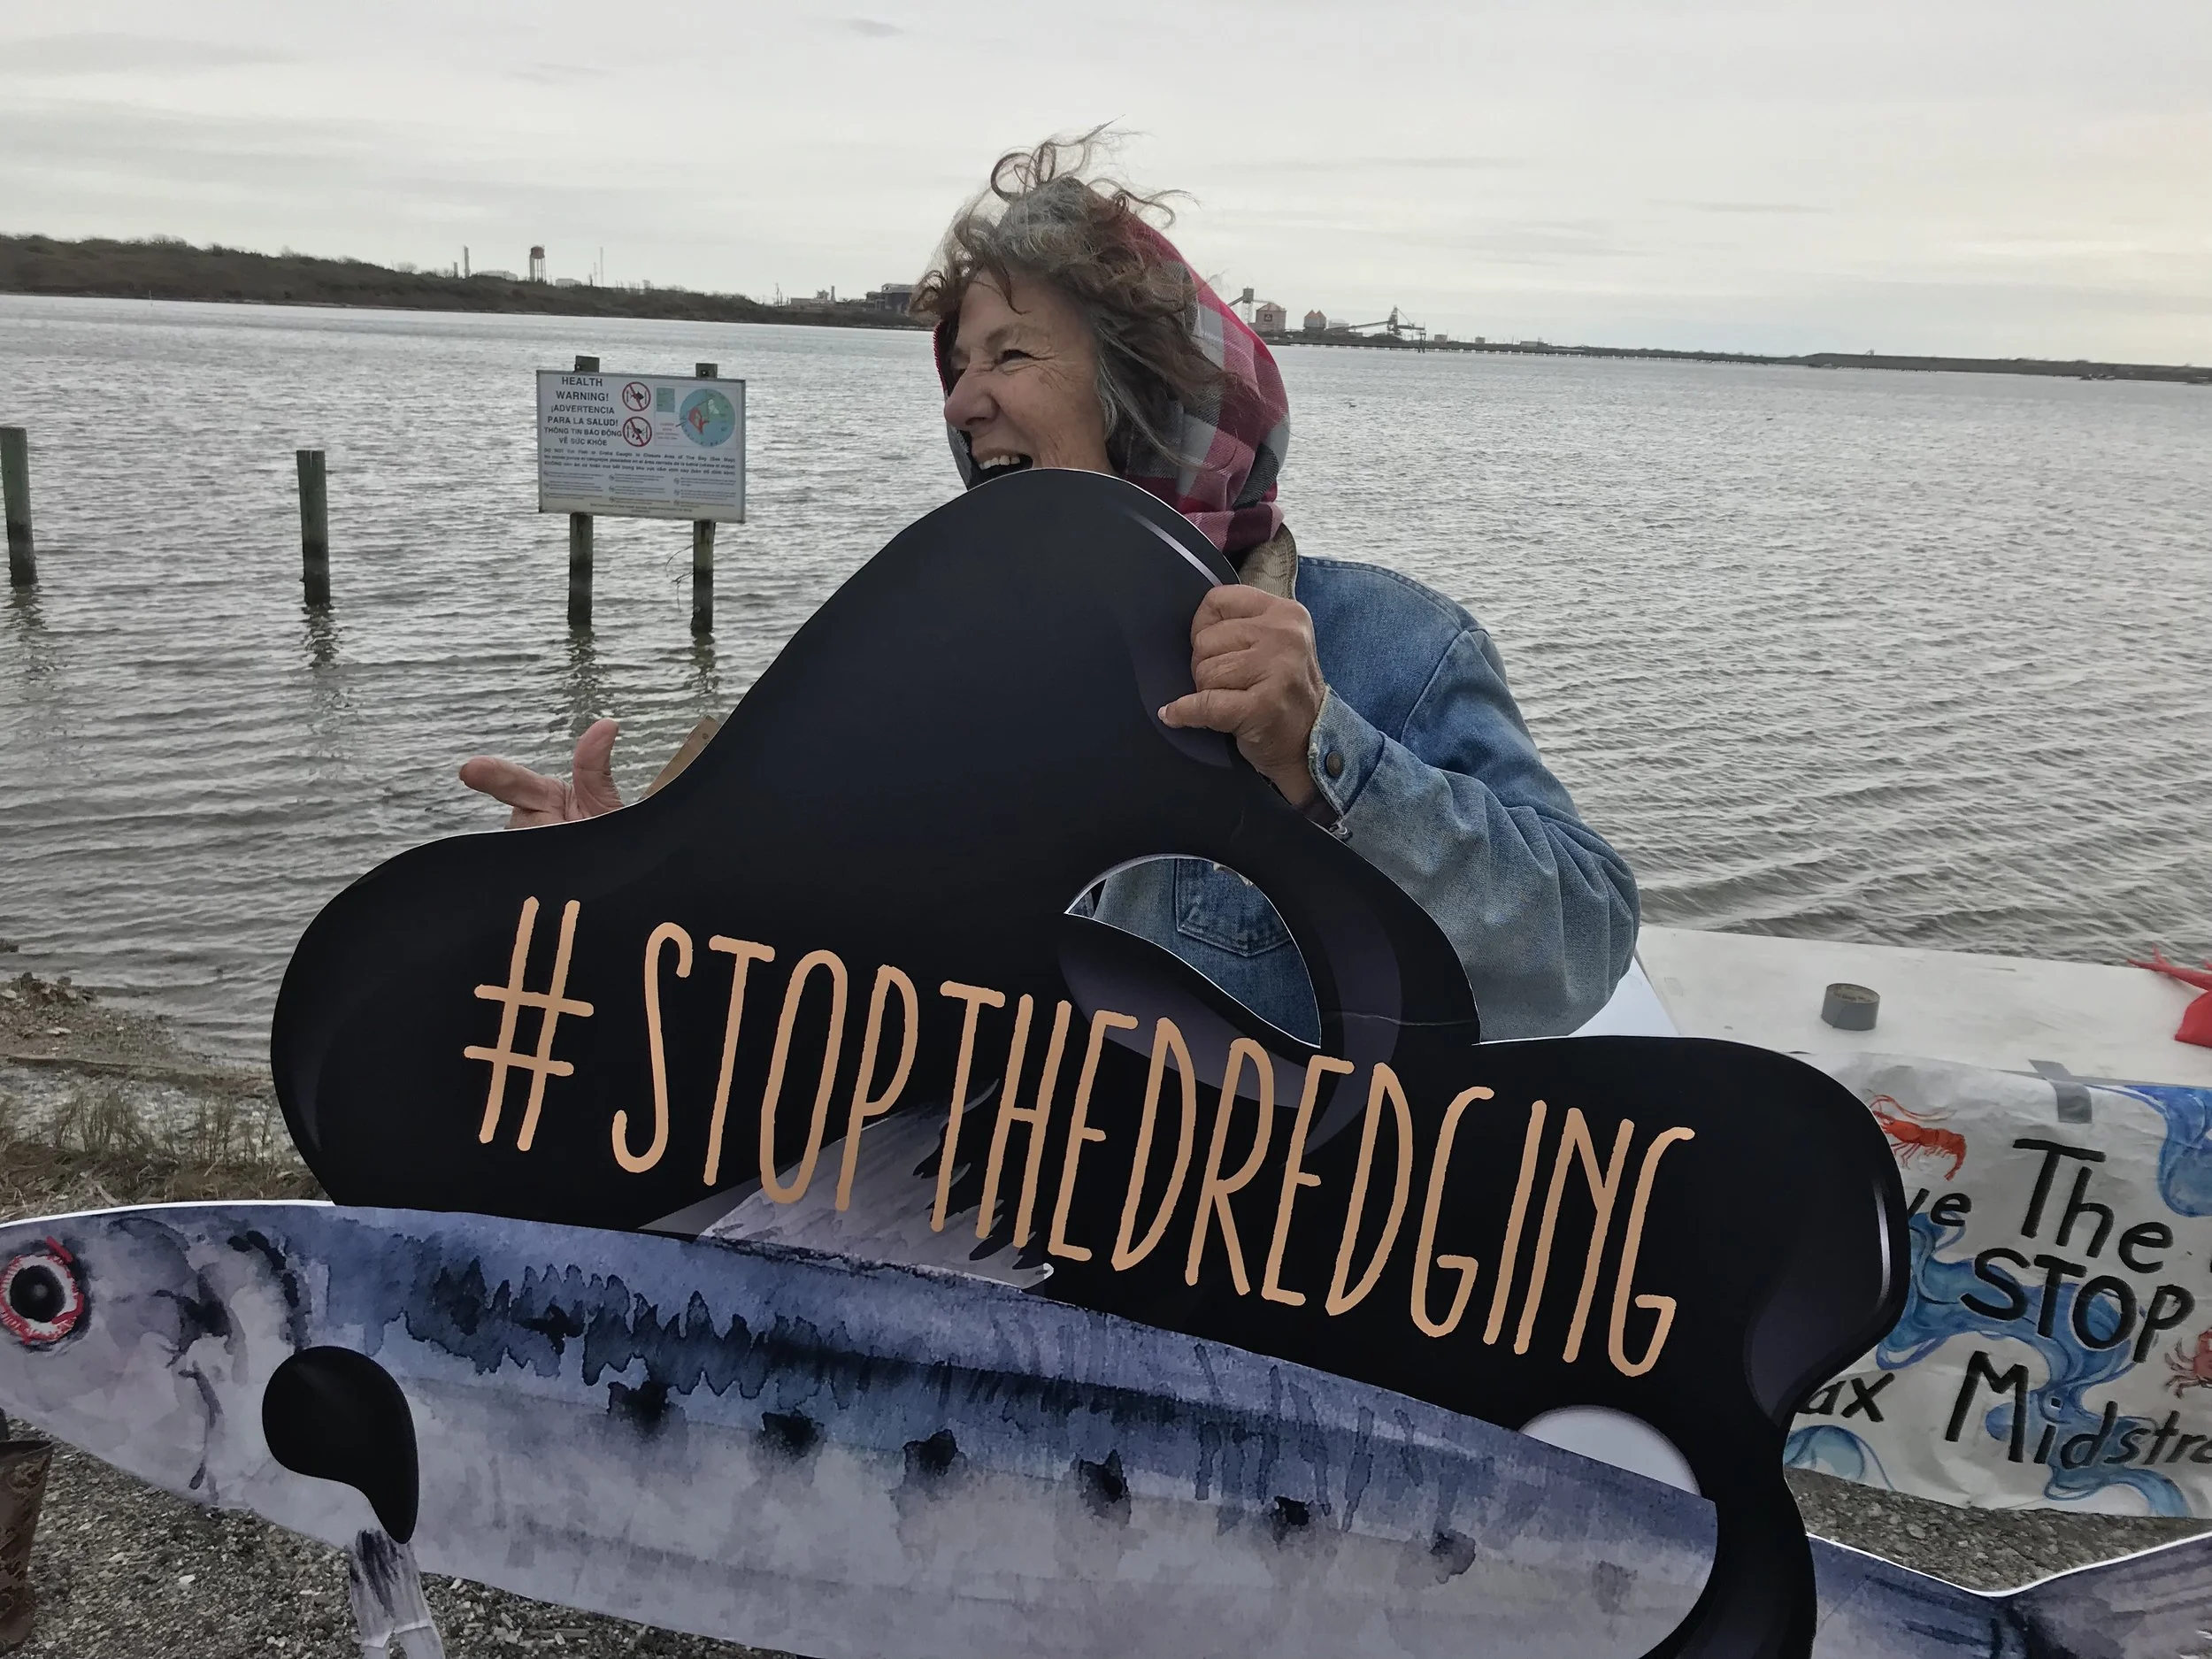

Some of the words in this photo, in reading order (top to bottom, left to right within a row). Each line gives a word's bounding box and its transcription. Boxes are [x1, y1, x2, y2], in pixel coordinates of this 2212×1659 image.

[561, 376, 603, 387] HEALTH
[556, 390, 609, 402] WARNING!
[587, 418, 618, 426] SALUD!
[2013, 1138, 2174, 1274] The
[1960, 1248, 2196, 1363] STOP
